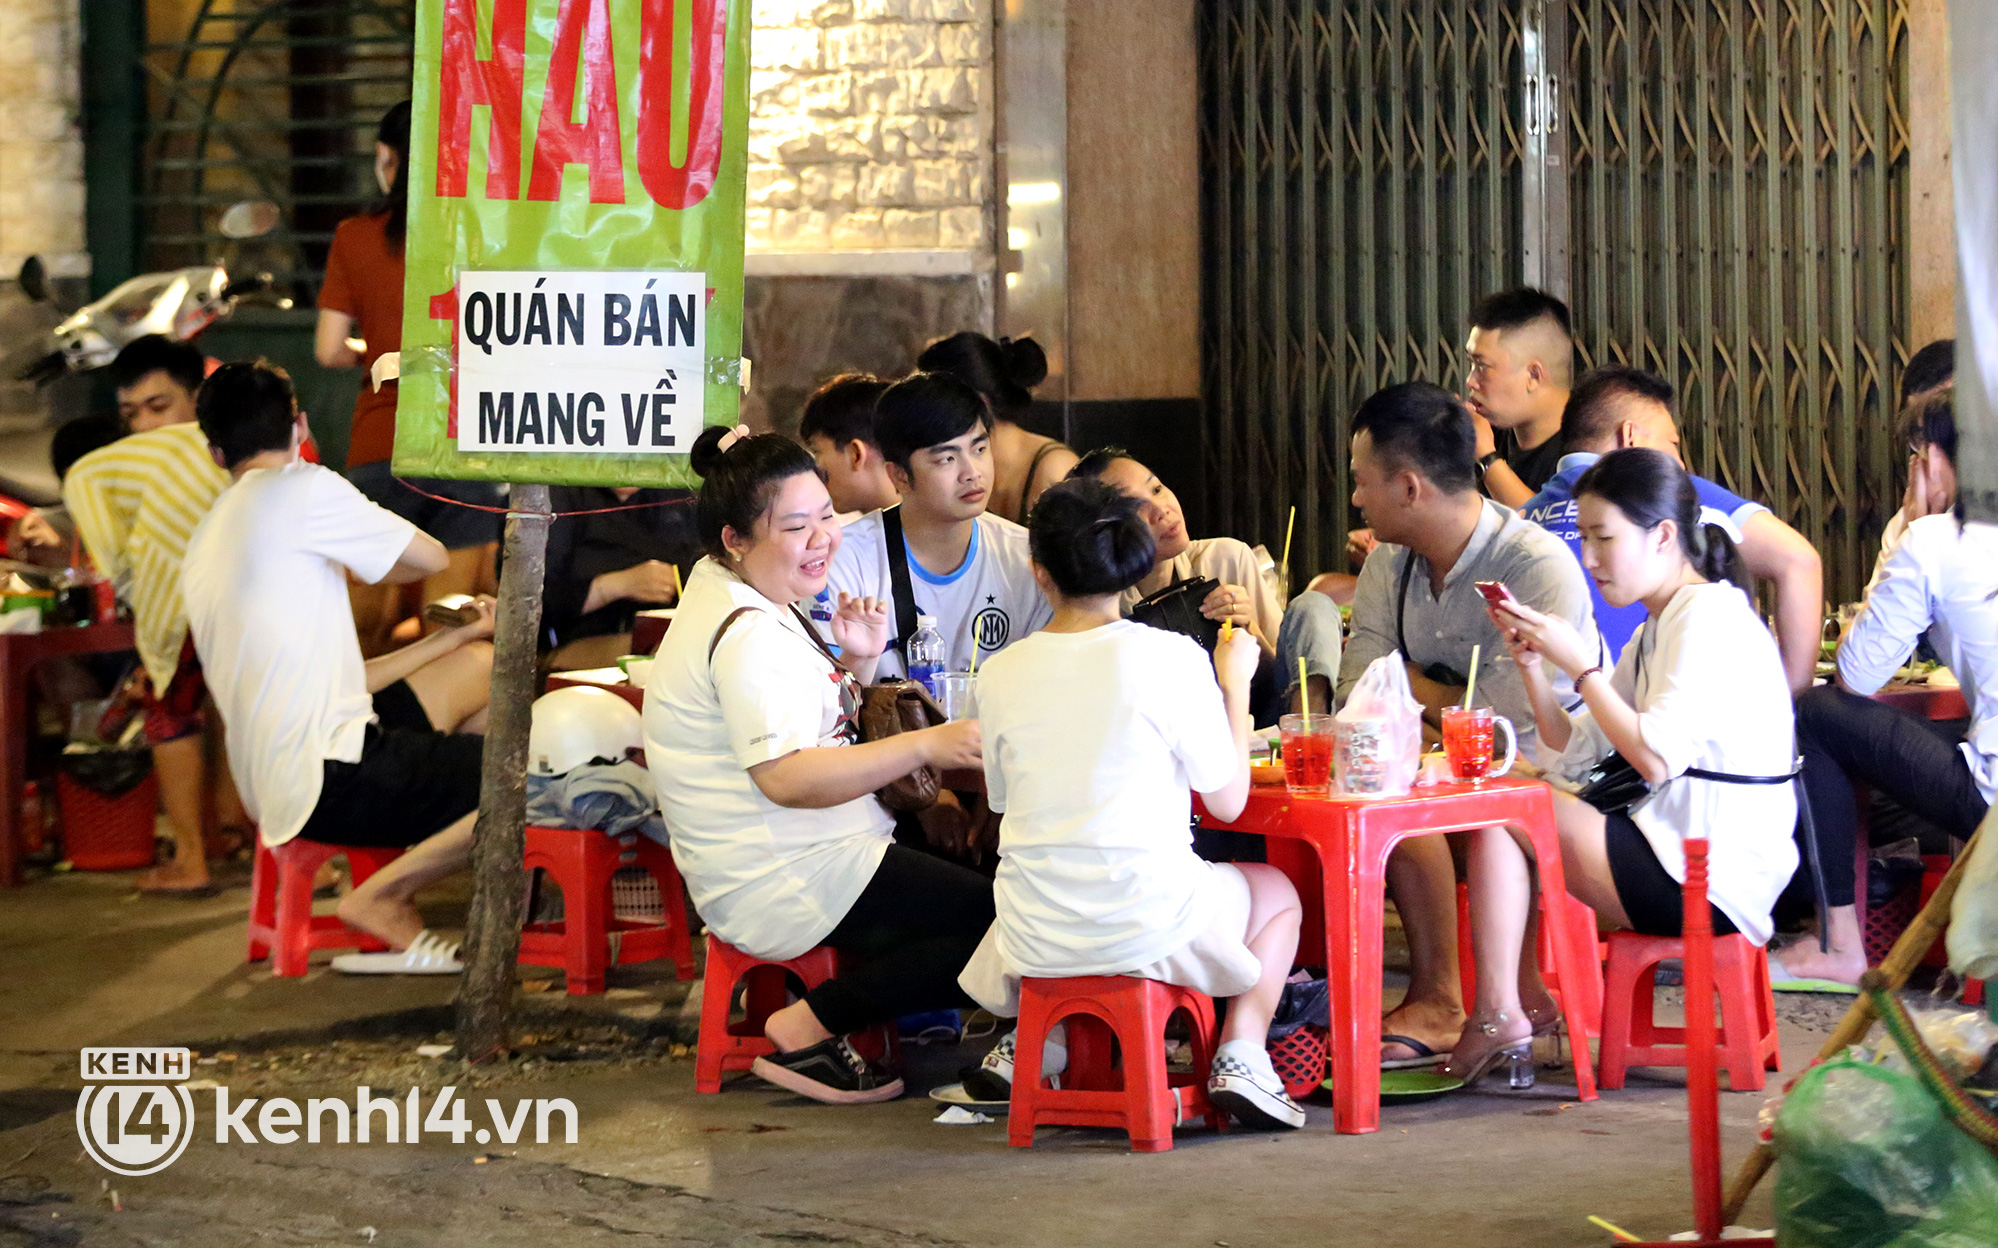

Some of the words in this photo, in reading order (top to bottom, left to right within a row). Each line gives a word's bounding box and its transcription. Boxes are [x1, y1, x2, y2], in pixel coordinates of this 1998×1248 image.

[464, 278, 585, 355] QUÁN
[603, 279, 696, 347] BÁN
[478, 391, 606, 446] MANG
[620, 369, 678, 447] VỀ
